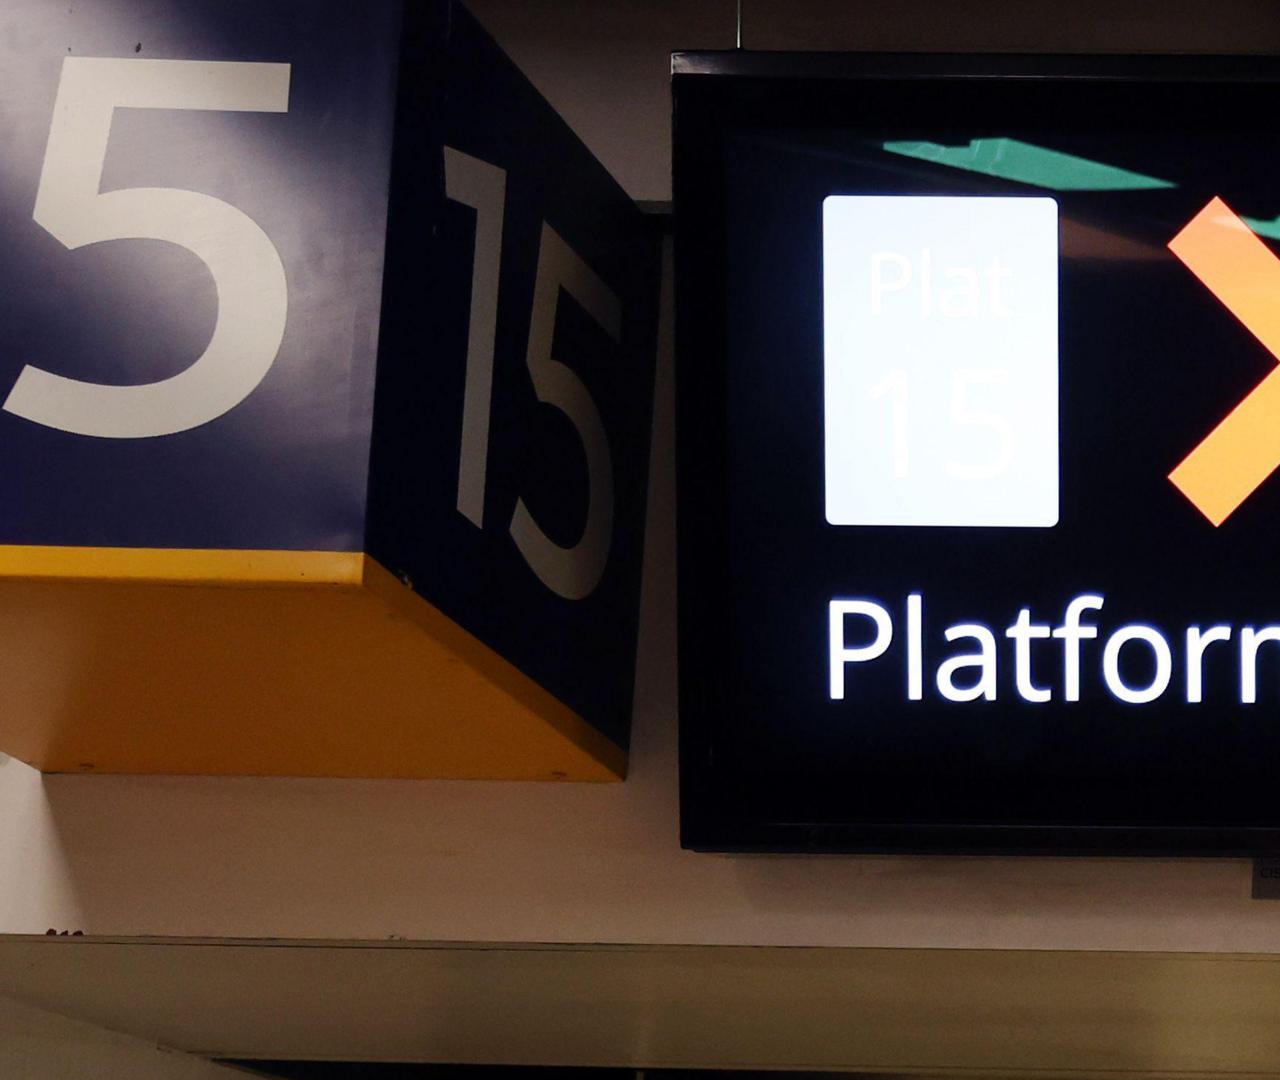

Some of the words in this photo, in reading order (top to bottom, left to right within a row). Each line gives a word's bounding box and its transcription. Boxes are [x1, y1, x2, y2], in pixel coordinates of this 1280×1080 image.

[2, 57, 291, 438] 5
[869, 246, 1014, 320] Plat
[443, 145, 622, 600] 15
[866, 367, 1014, 480] 15
